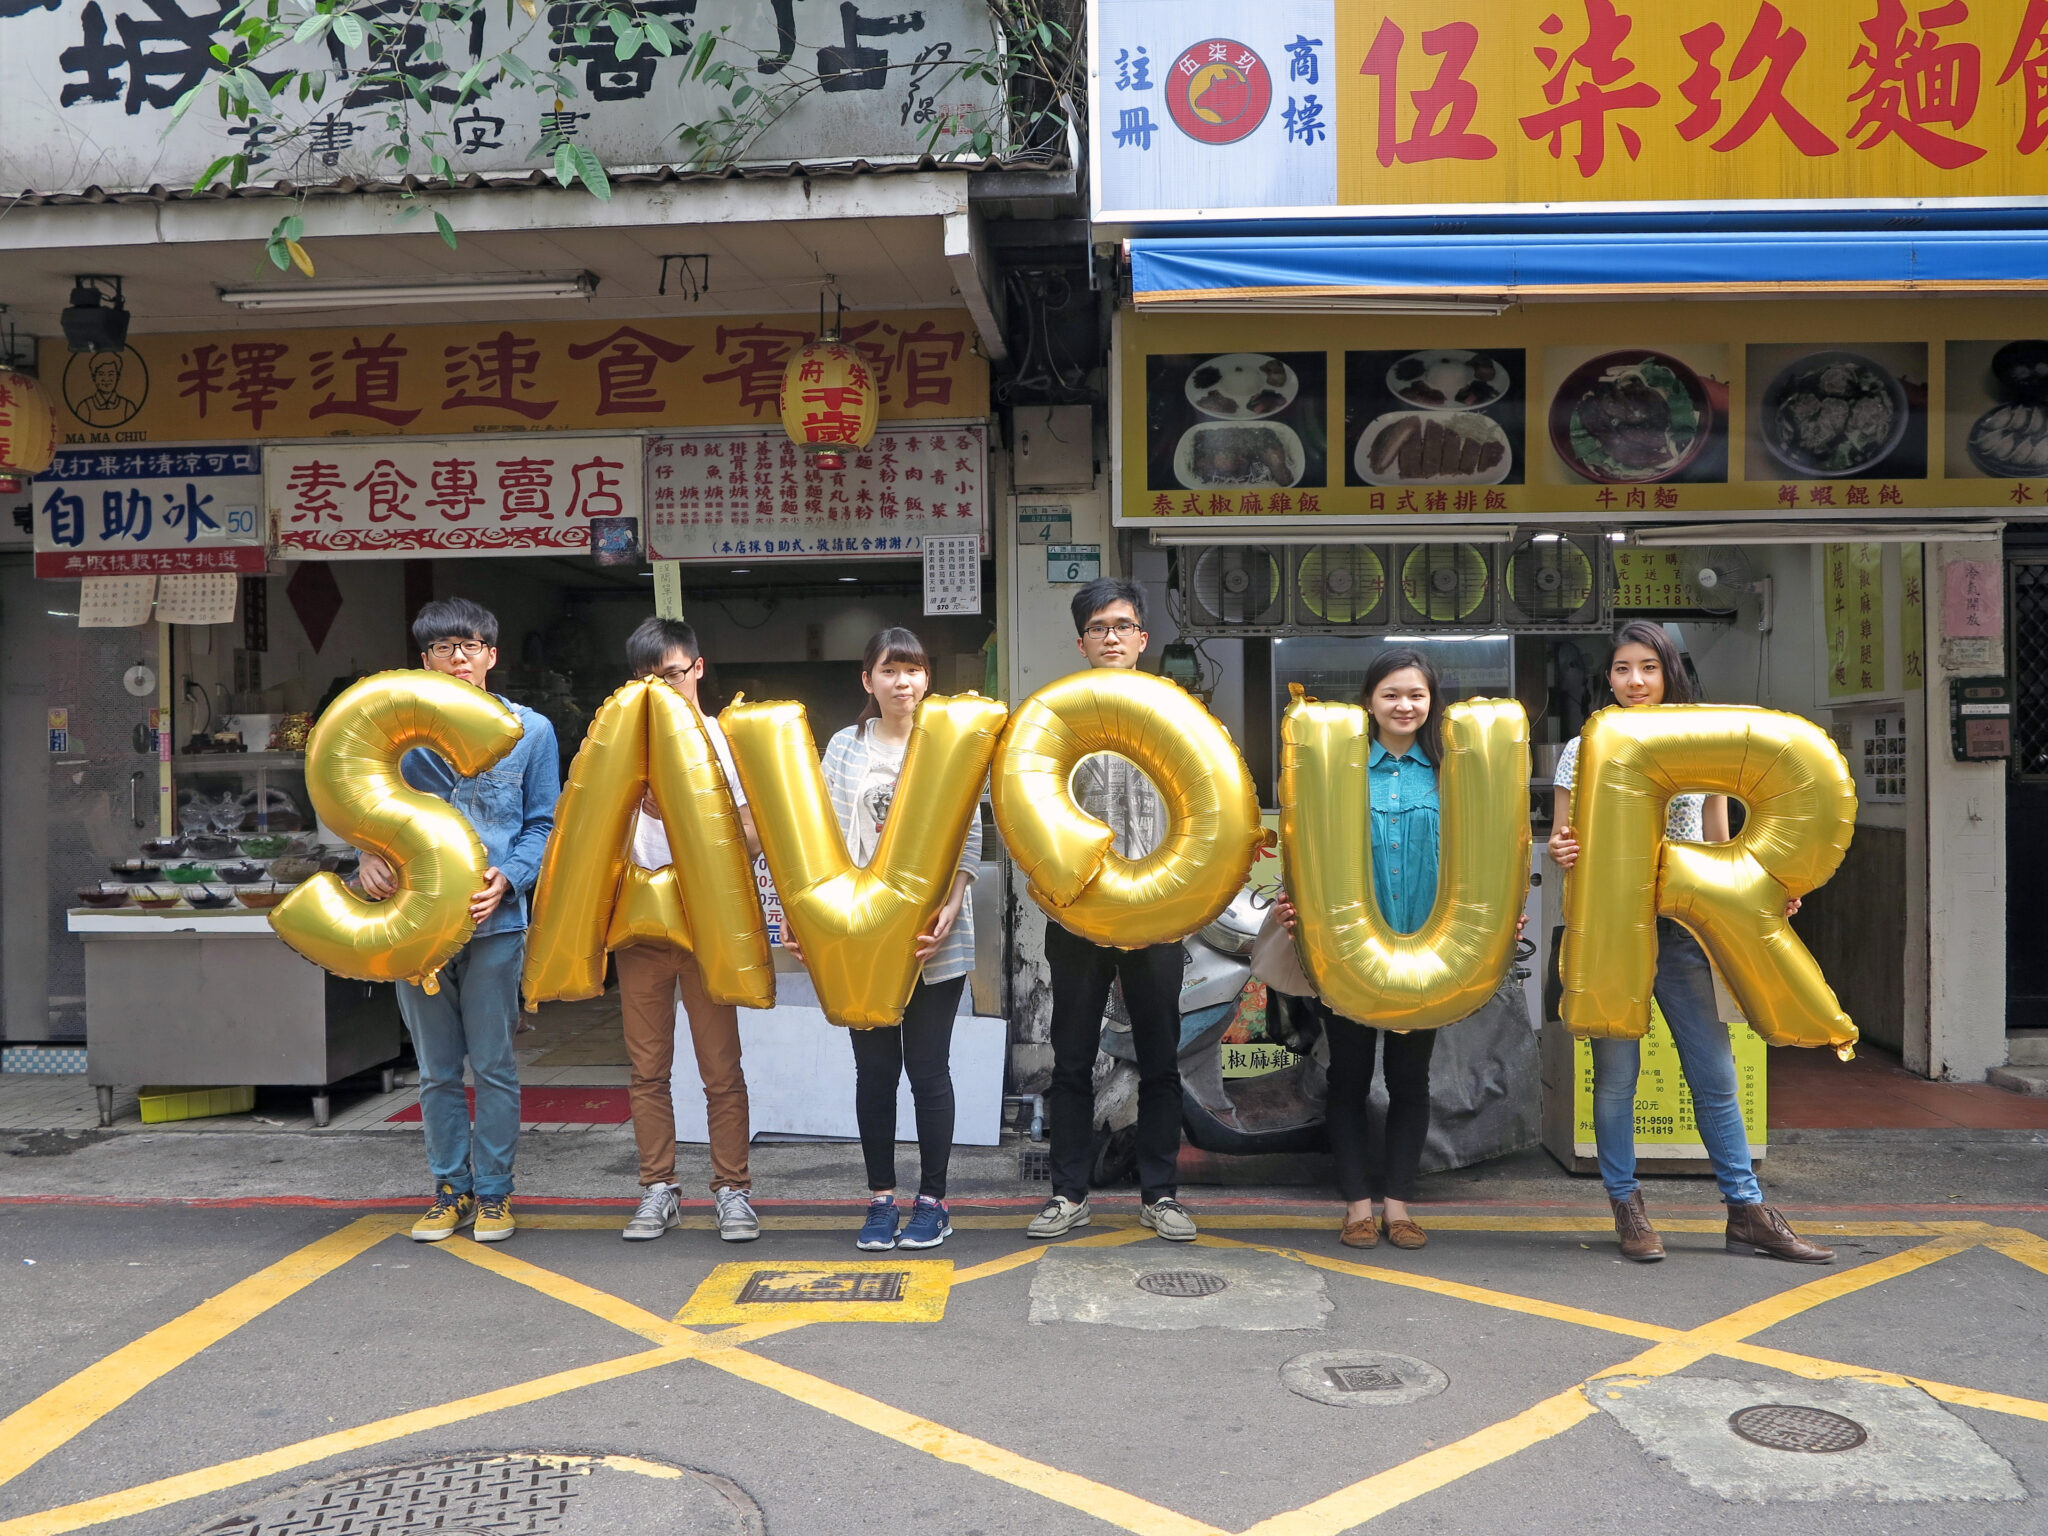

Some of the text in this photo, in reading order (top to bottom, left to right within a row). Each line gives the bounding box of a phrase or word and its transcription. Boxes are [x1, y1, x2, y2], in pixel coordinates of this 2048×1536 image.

[1178, 43, 1257, 76] 伍柒玖
[1112, 46, 1158, 150] 註冊
[1281, 35, 1325, 146] 商標
[65, 431, 147, 444] MA MA CHIU
[905, 436, 924, 512] 素肉飯
[930, 436, 948, 518] 燙青菜
[955, 435, 974, 518] 各式小菜
[286, 456, 625, 525] 素食專賣店
[1369, 489, 1508, 512] 日式豬排飯
[1595, 486, 1679, 509] 牛肉麵
[1777, 483, 1903, 508] 鮮蝦餛飩
[2009, 482, 2048, 504] 水
[42, 483, 221, 547] 自助冰
[1152, 492, 1321, 516] 泰式椒麻雞飯
[227, 510, 253, 533] 50
[1039, 523, 1051, 541] 4
[1066, 562, 1080, 580] 6
[1966, 566, 1980, 626] 冷氣開放
[1221, 1049, 1303, 1070] 椒麻雞
